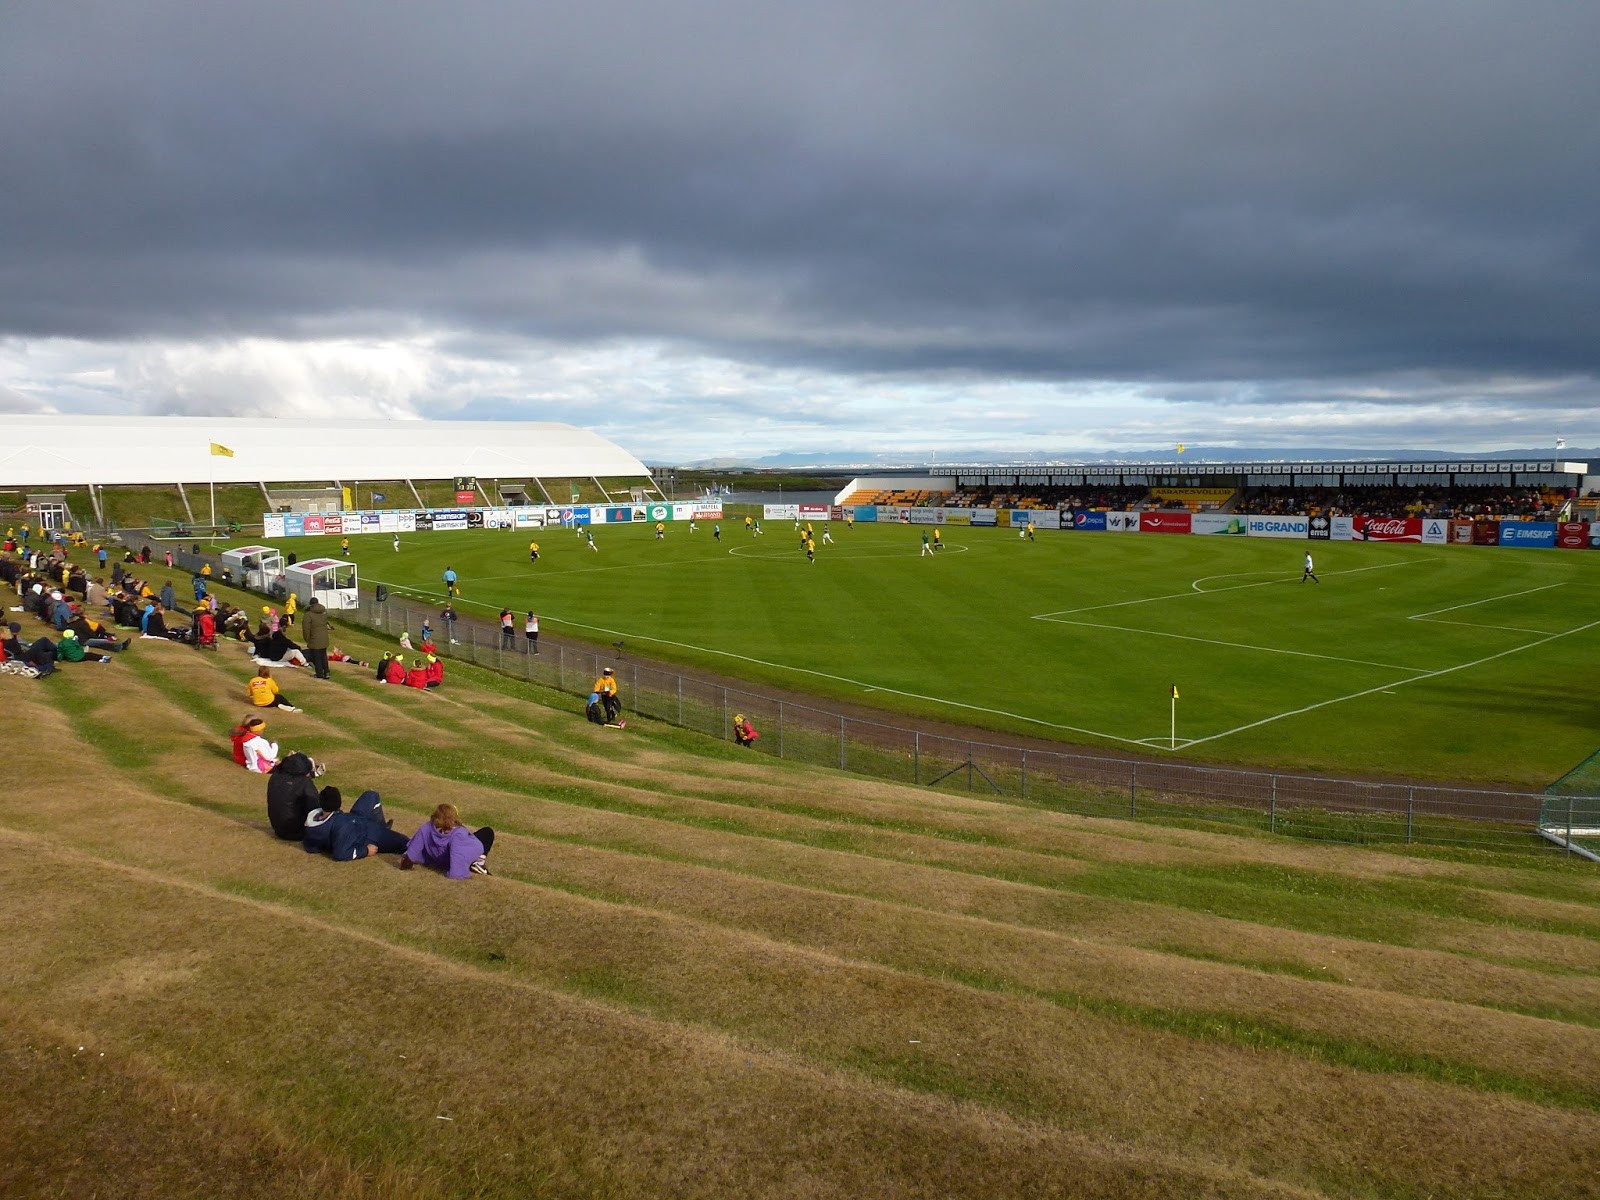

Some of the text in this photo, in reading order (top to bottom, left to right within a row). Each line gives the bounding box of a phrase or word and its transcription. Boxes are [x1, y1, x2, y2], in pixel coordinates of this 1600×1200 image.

[1087, 517, 1104, 525] pepsi
[1250, 521, 1308, 533] HB GRANDI
[1516, 529, 1552, 538] EIMSKIP
